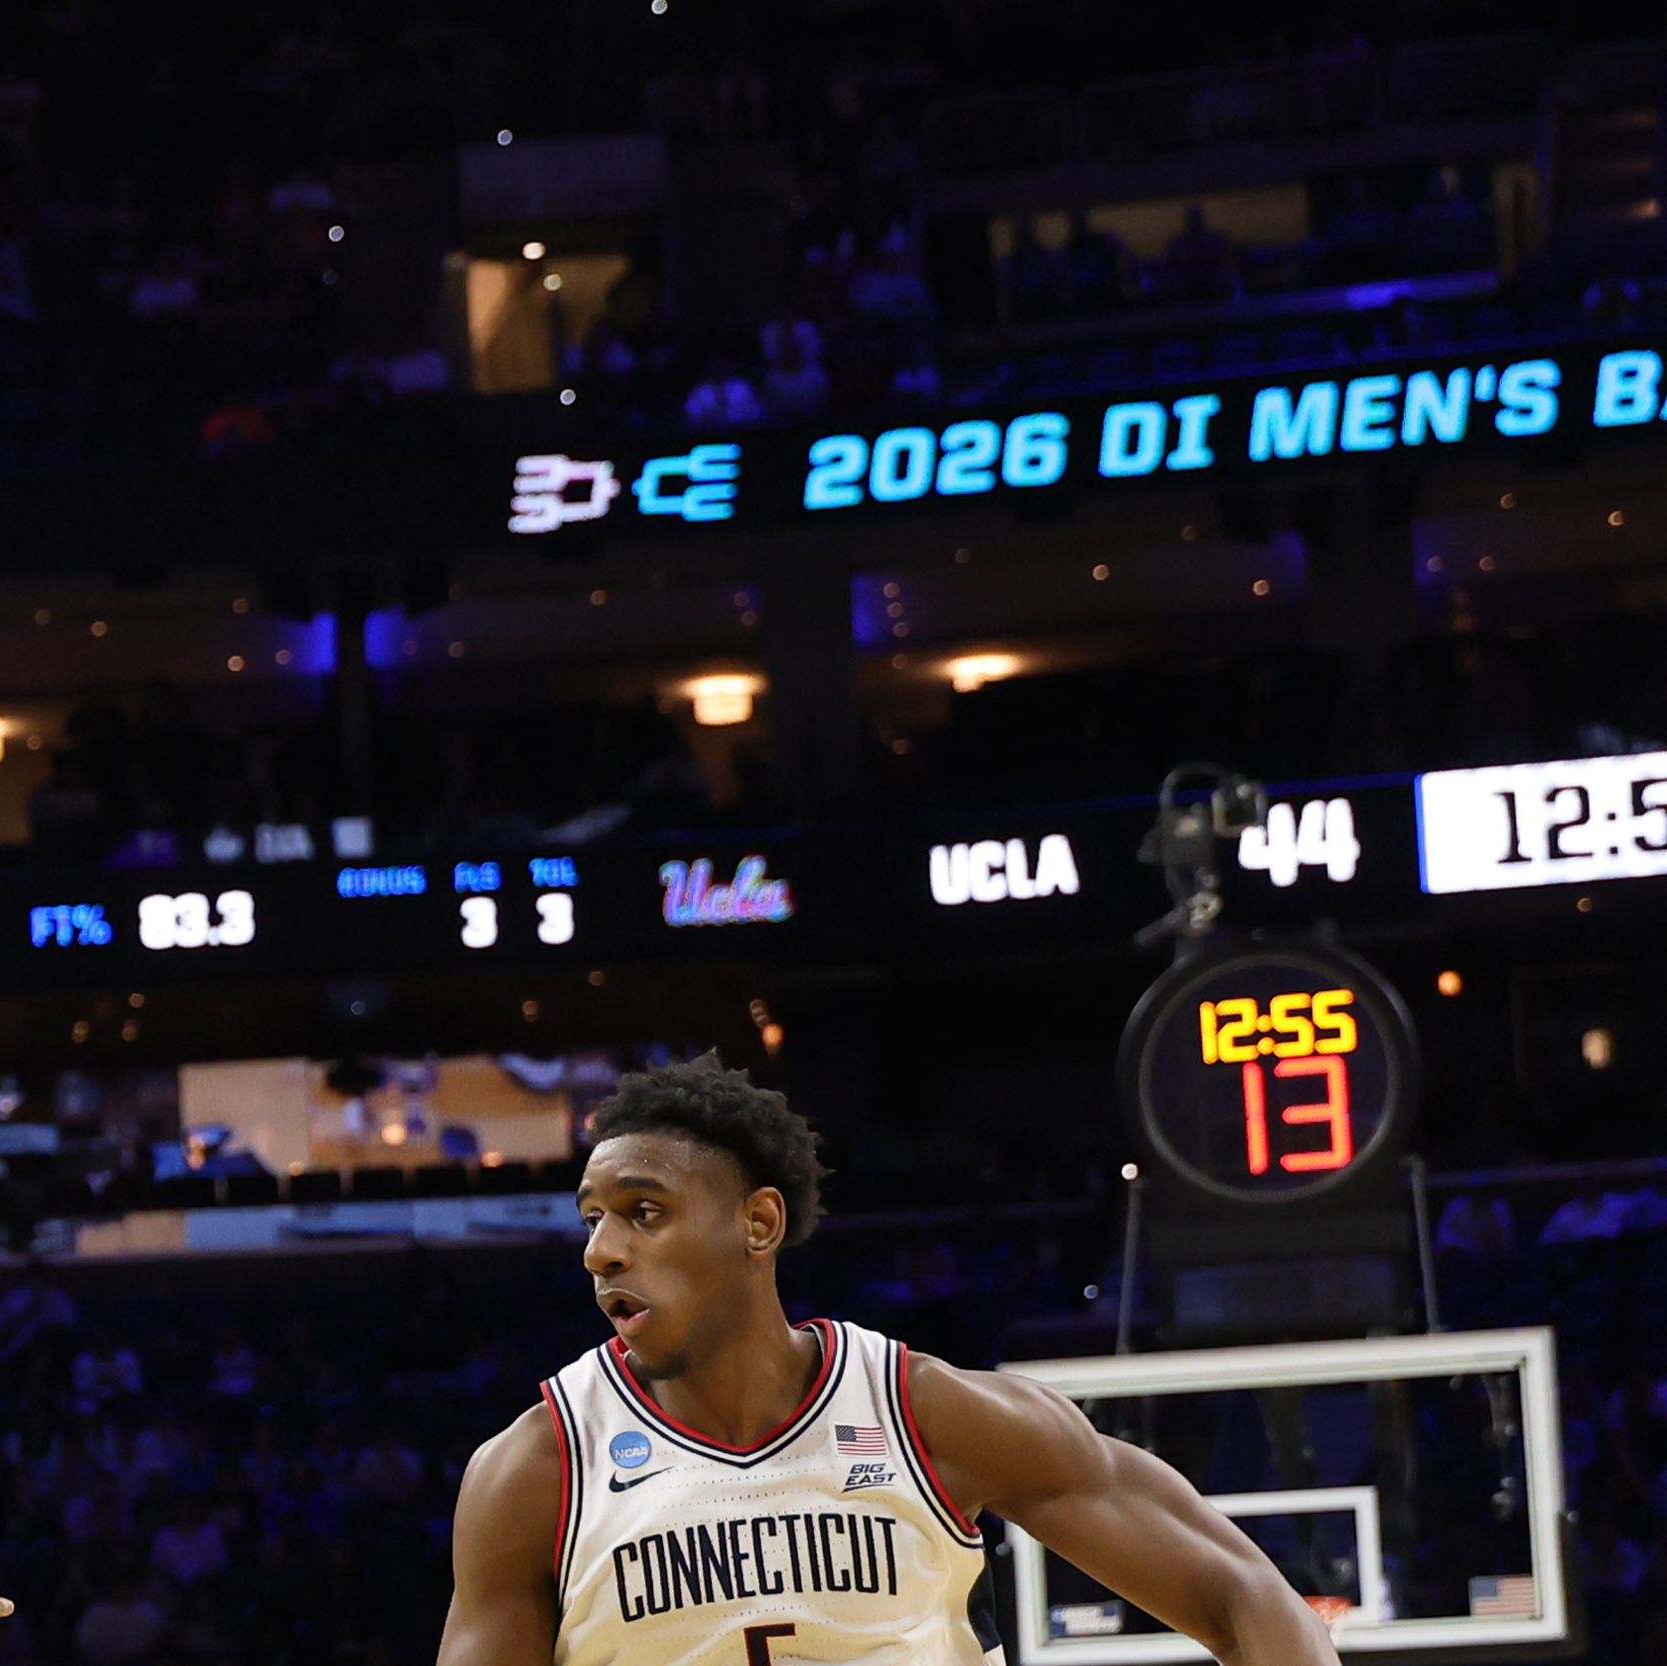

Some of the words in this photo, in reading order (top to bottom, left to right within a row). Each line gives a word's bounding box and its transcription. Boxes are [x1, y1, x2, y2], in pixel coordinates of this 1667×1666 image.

[804, 412, 1069, 509] 2026
[1098, 395, 1220, 477] DI
[1249, 359, 1561, 461] MEN'S
[1592, 350, 1667, 427] B
[930, 834, 1079, 904] UCLA
[1238, 799, 1359, 886] 44
[1200, 989, 1357, 1064] 12:55
[1243, 1055, 1353, 1175] 13
[845, 1473, 897, 1486] EAST
[849, 1463, 886, 1474] BIG
[612, 1513, 897, 1624] CONNECTICUT
